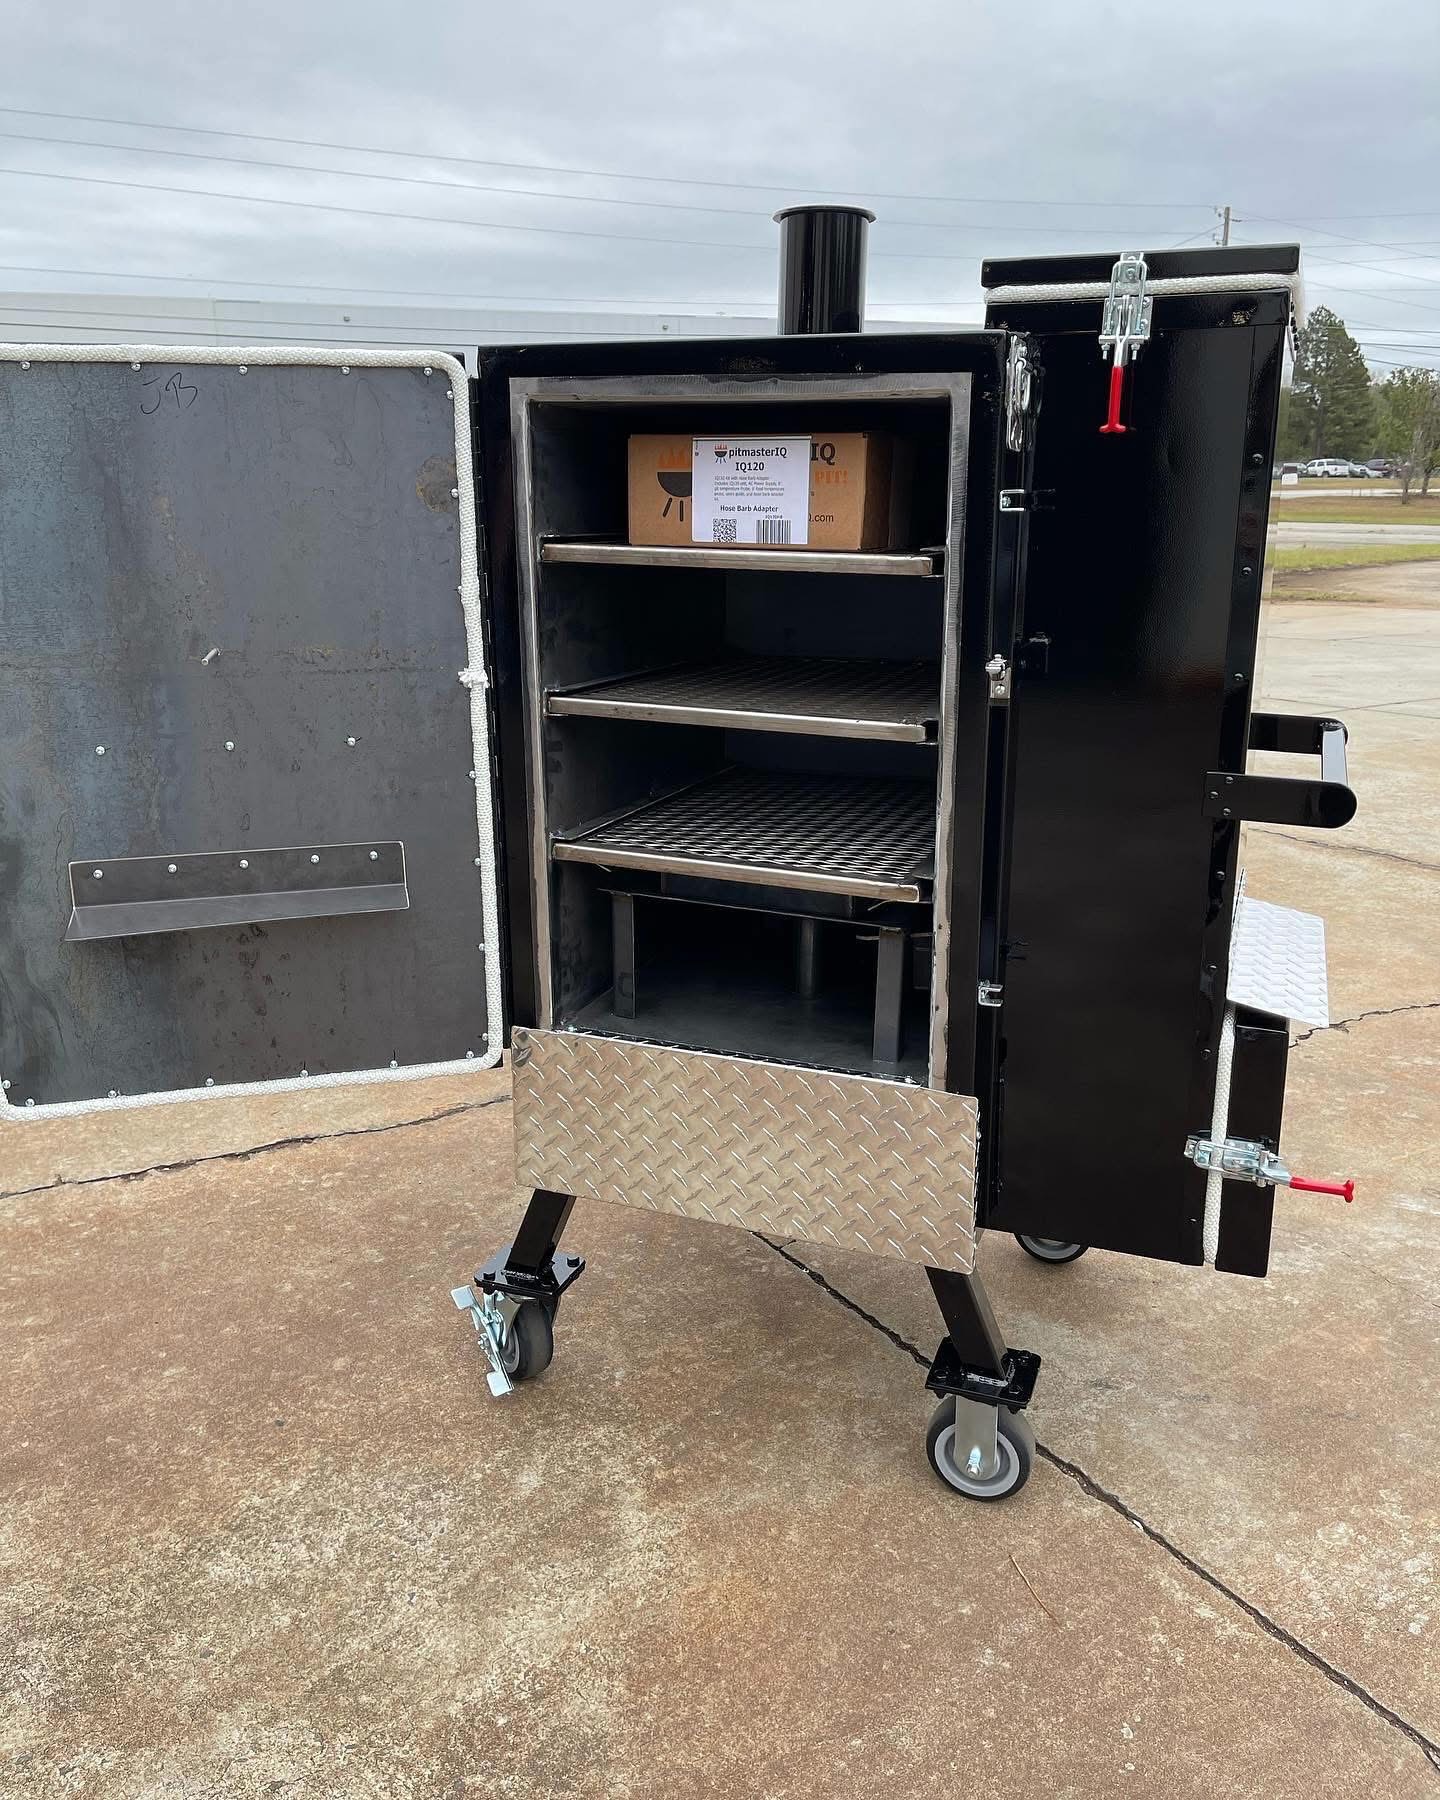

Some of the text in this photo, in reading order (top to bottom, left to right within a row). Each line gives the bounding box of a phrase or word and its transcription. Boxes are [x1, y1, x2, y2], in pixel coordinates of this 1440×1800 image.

[728, 447, 787, 459] pitmasterIQ
[735, 462, 765, 473] IQ120
[720, 504, 779, 513] Hose Barb Adapter
